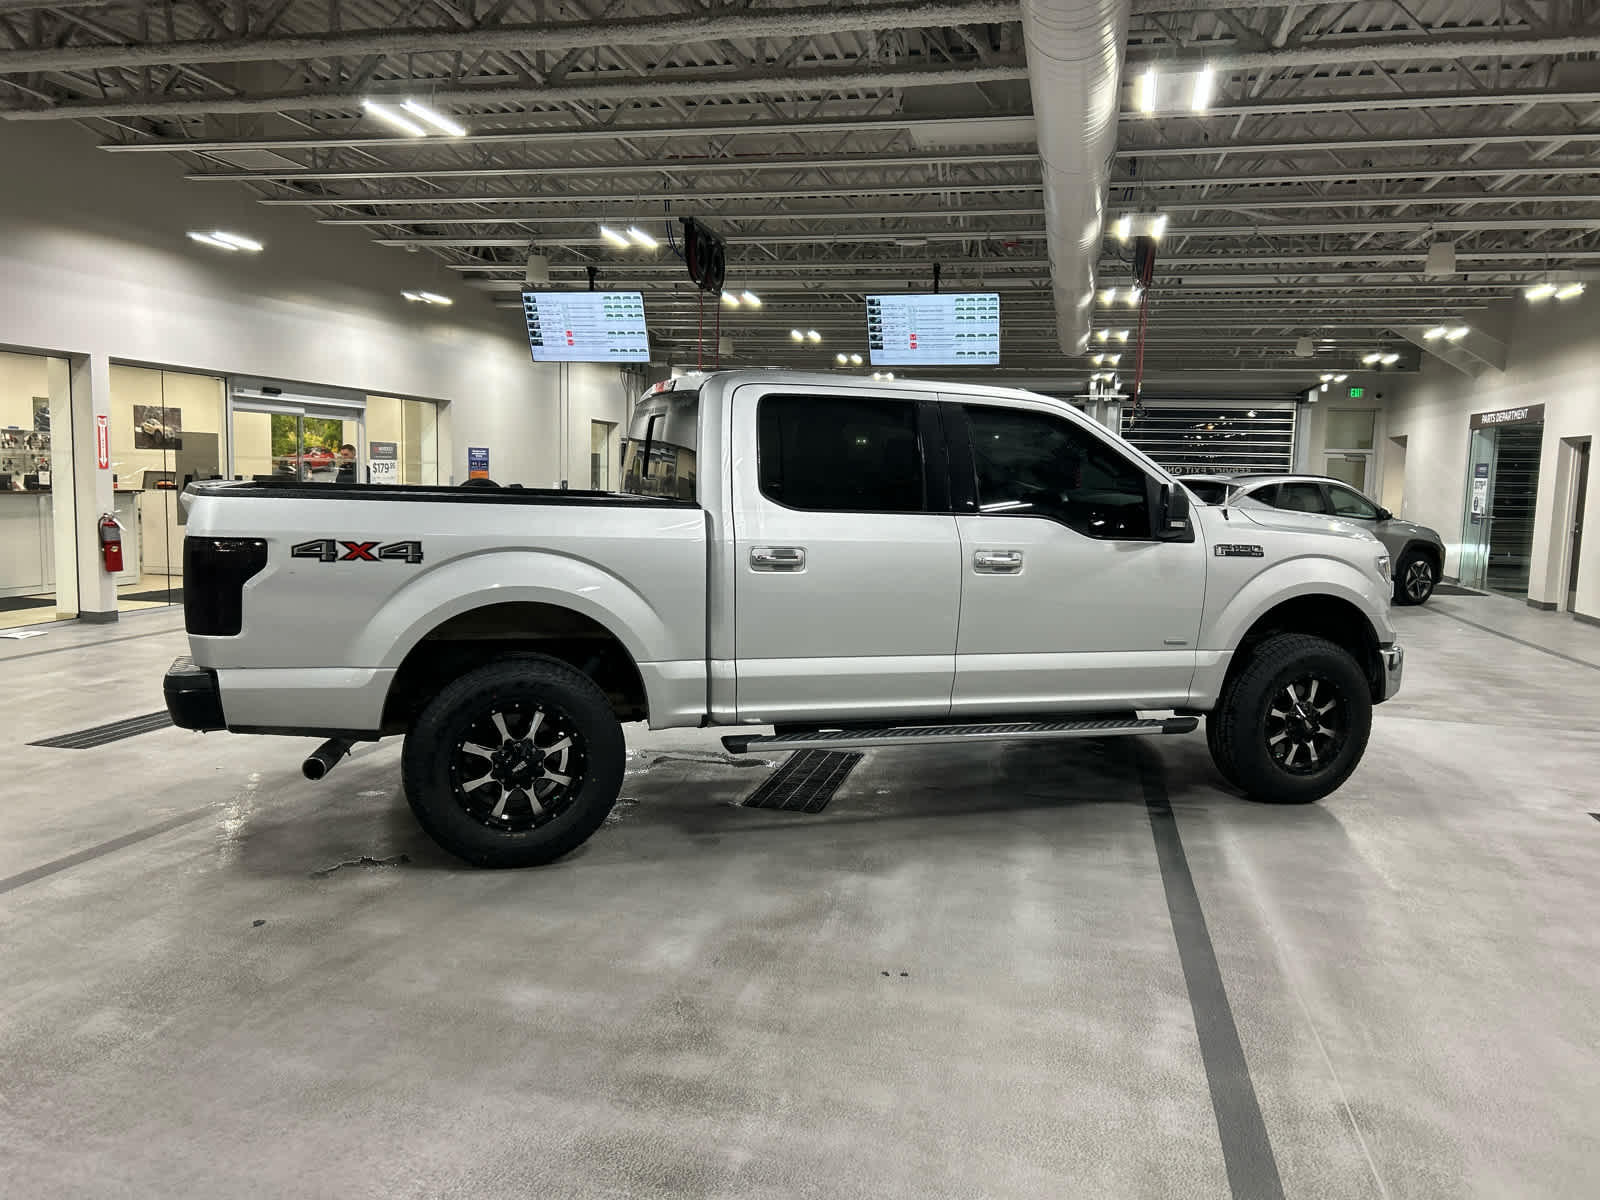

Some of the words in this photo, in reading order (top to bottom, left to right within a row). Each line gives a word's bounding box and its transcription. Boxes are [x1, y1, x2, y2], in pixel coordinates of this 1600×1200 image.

[1351, 388, 1364, 397] EXIT
[1481, 413, 1496, 424] PARTS
[1496, 409, 1528, 422] DEPARTMENT
[372, 462, 389, 473] $179
